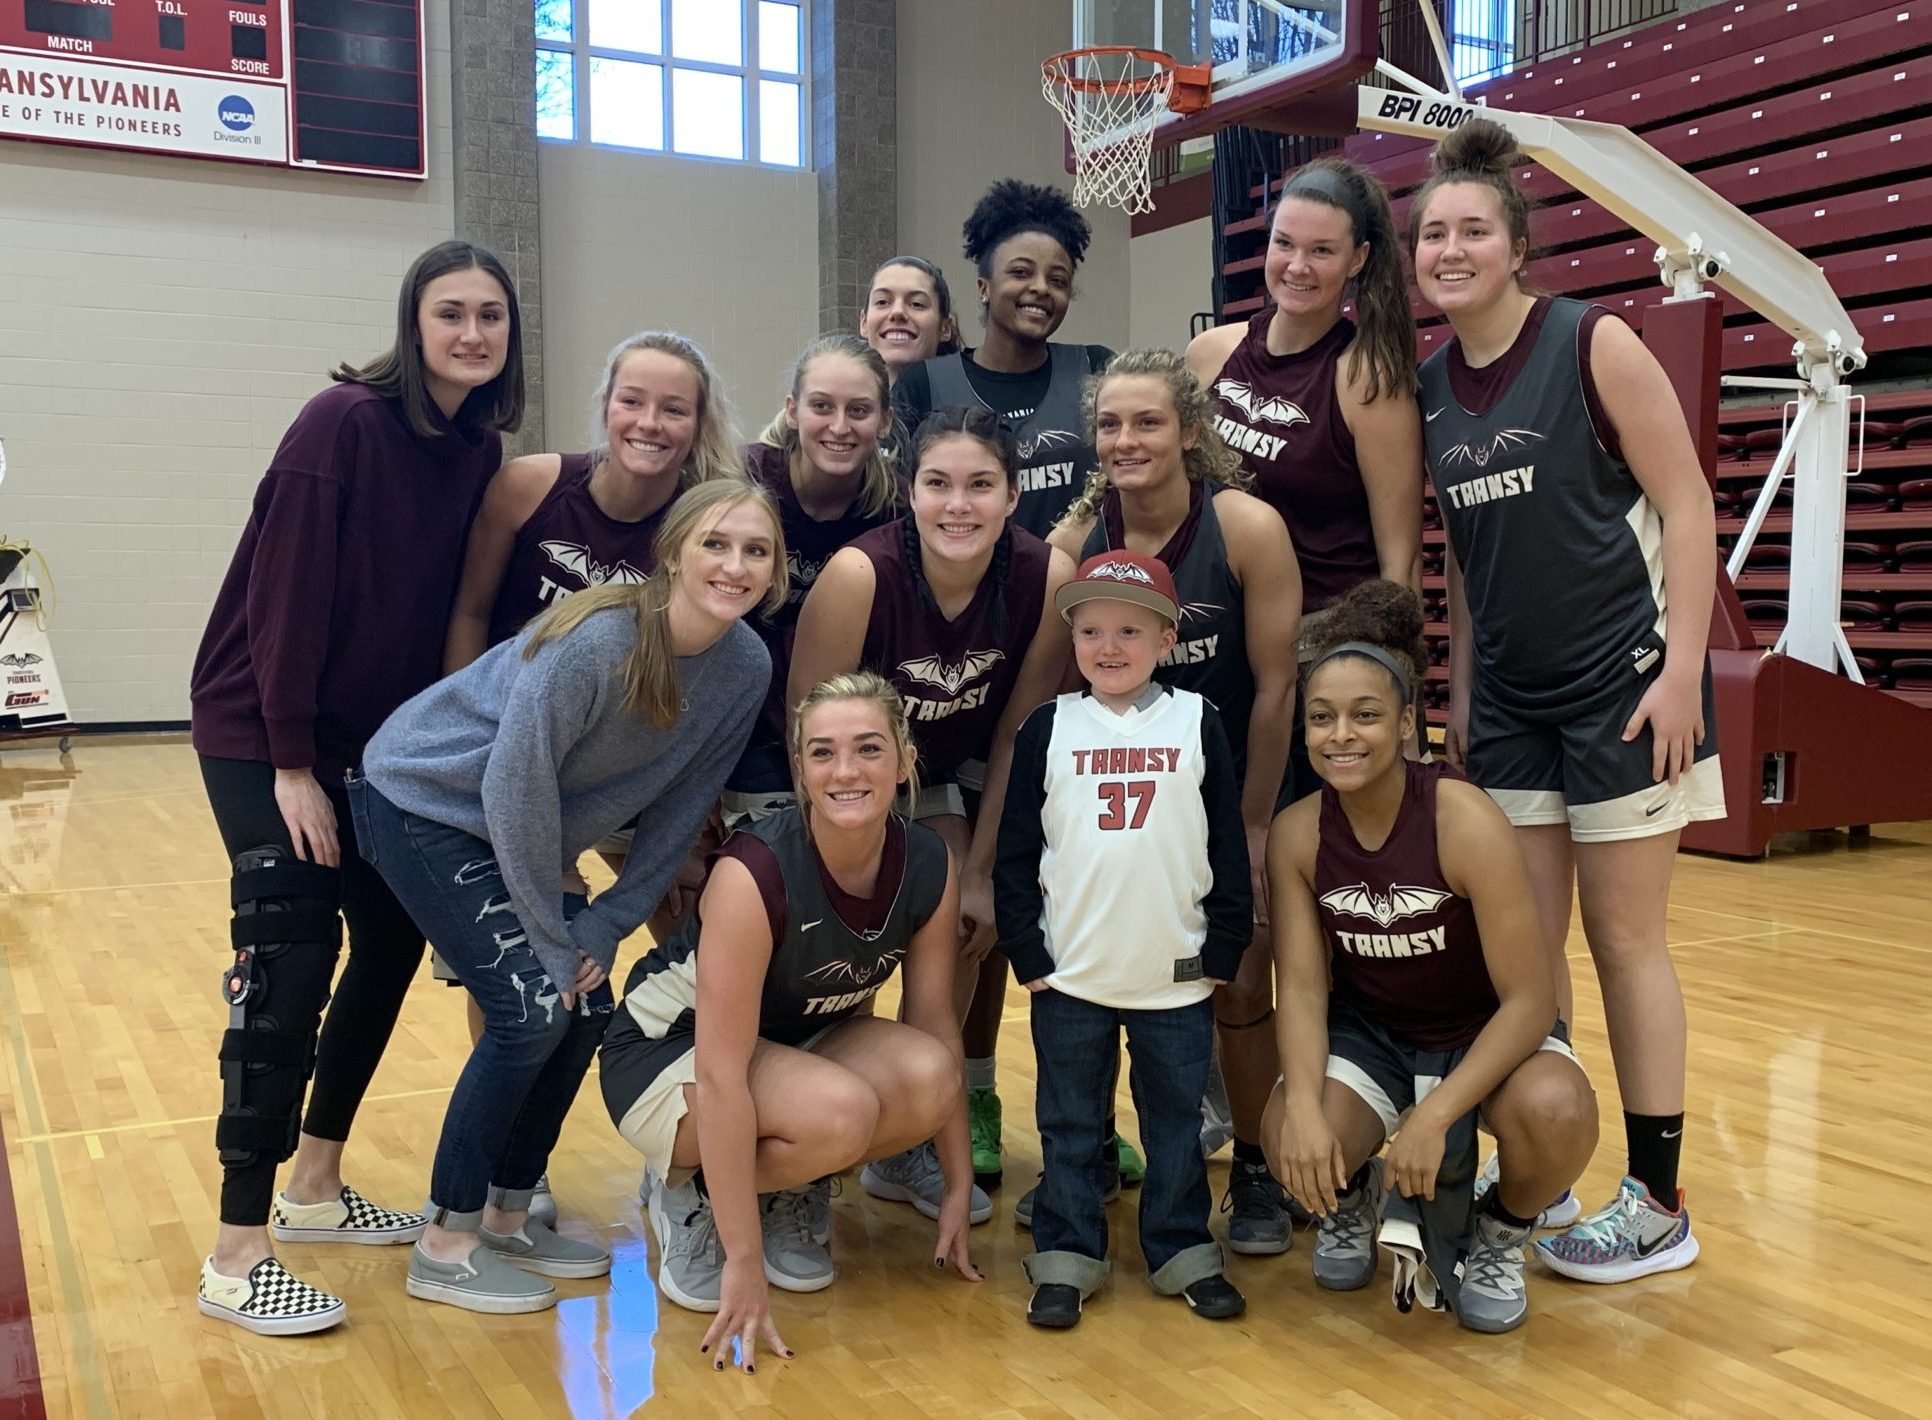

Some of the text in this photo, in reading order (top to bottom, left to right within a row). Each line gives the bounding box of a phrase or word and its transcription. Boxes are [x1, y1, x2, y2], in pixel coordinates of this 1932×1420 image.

[155, 1, 188, 15] T.O.L.
[229, 10, 267, 26] FOULS
[47, 36, 93, 53] MATCH
[231, 59, 270, 74] SCORE
[0, 67, 182, 113] ANSYLVANIA
[22, 106, 42, 121] OF
[53, 110, 86, 126] THE
[96, 115, 182, 137] PIONEERS
[221, 111, 254, 124] NCAA
[1378, 94, 1422, 122] BPI
[213, 130, 252, 144] Division
[1213, 414, 1288, 462] TRANSY
[1447, 465, 1535, 510] TRANSY
[1631, 647, 1650, 660] XL
[1072, 747, 1181, 776] TRANSY
[1098, 780, 1156, 831] 37
[1336, 925, 1446, 958] TRANSY
